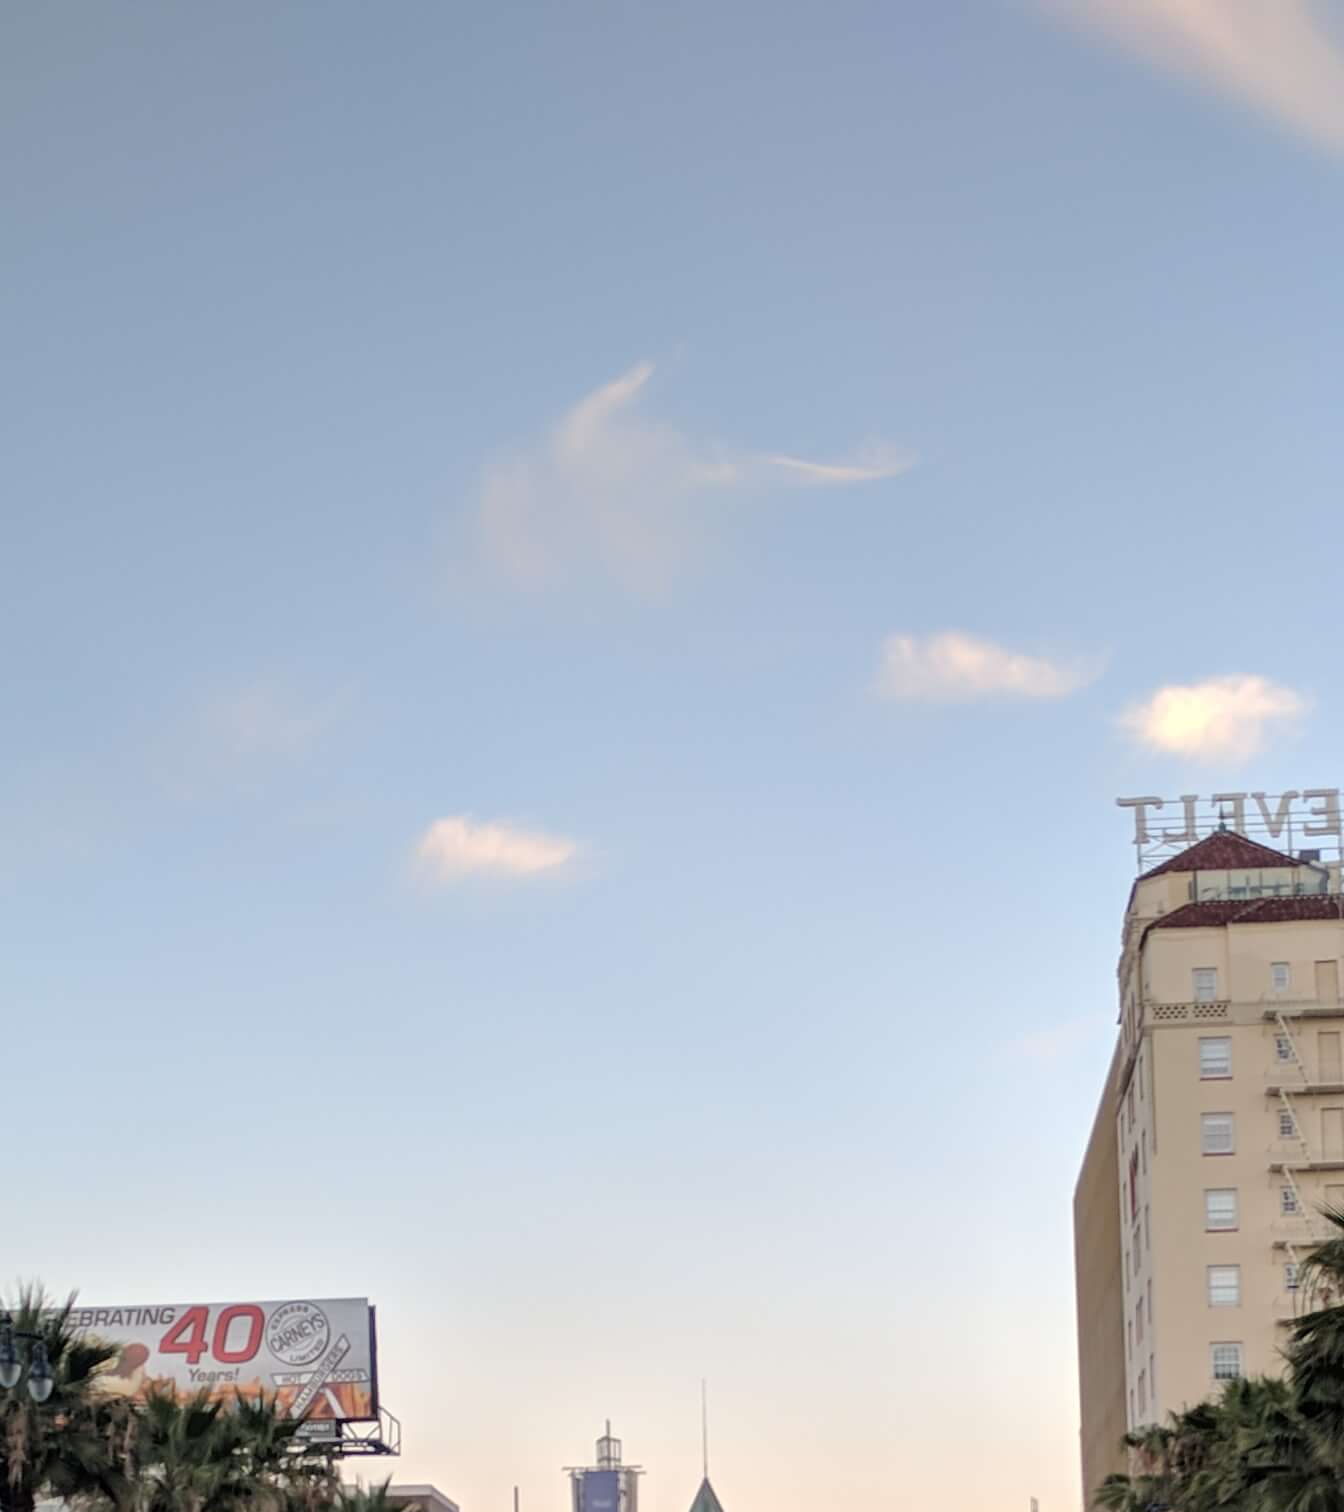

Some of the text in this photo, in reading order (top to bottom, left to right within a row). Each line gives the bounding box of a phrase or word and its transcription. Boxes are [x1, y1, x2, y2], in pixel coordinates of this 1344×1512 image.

[54, 1303, 264, 1364] EBRATING 40
[270, 1312, 326, 1353] CARNEYS
[188, 1367, 239, 1384] Years!
